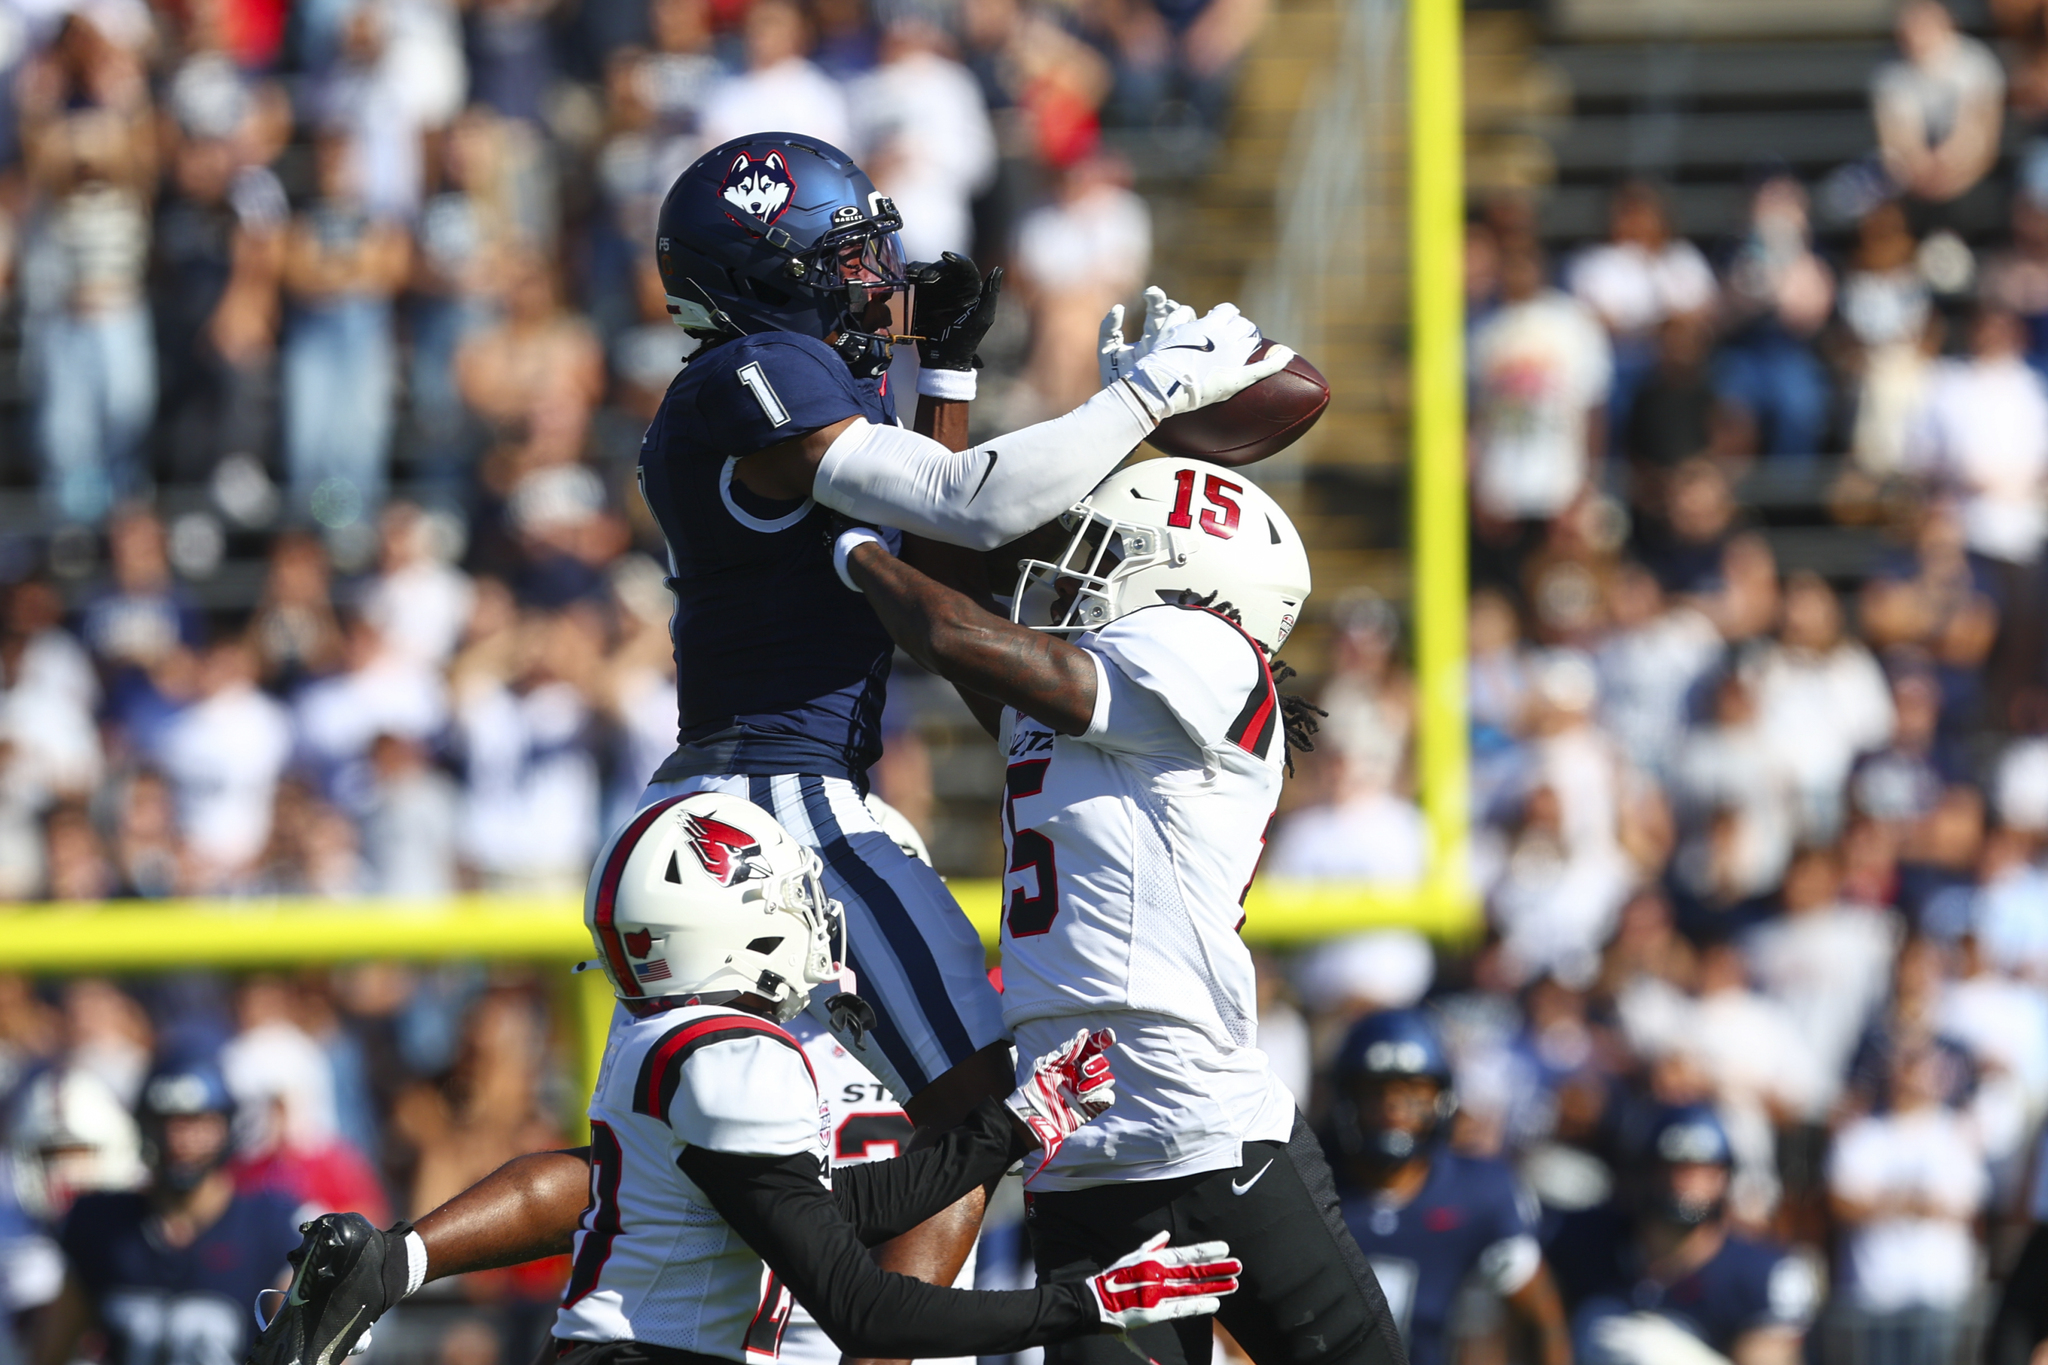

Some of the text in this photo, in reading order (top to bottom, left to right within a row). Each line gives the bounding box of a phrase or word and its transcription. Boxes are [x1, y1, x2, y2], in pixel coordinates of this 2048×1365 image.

[834, 214, 863, 223] OAKLEY
[736, 361, 791, 428] 1
[1167, 468, 1243, 540] 15
[999, 757, 1060, 940] 5
[841, 1083, 893, 1103] ST
